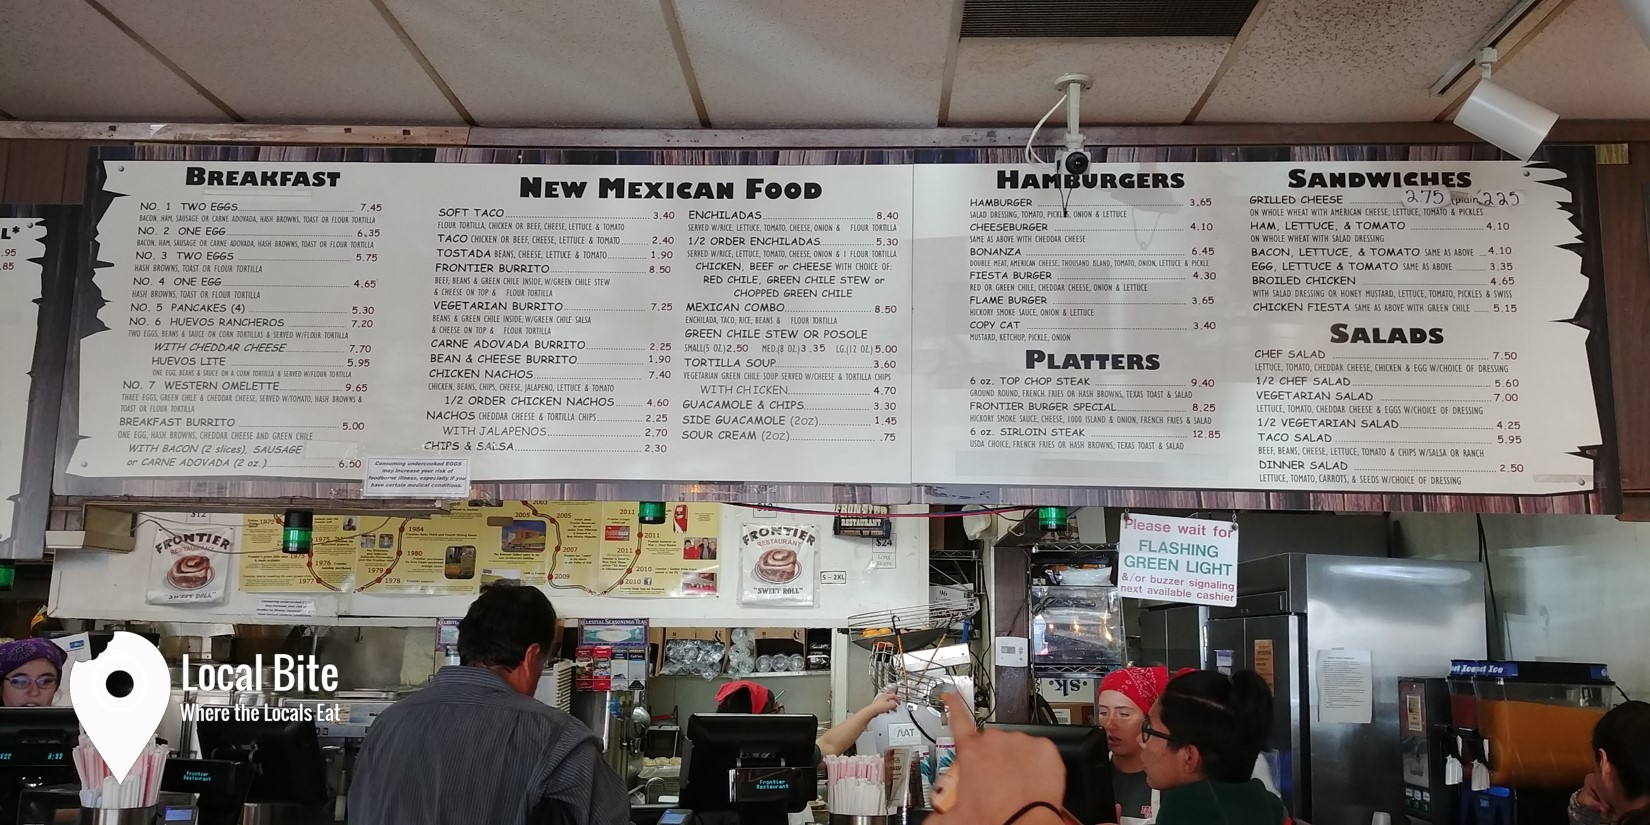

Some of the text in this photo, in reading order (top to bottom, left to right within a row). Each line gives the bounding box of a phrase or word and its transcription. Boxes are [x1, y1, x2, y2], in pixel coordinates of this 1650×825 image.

[186, 167, 340, 187] BREAKFAST
[520, 177, 822, 199] NEW MEXICAN FOOD
[971, 198, 1211, 207] HAMBURGER 3.65
[1250, 195, 1343, 204] GRILLED CHEESE
[211, 203, 239, 211] EGGS
[439, 208, 469, 217] SOFT
[474, 209, 504, 217] TACO
[689, 210, 898, 220] ENCHILADAS 8.40
[970, 223, 1048, 231] CHEESEBURGER
[1251, 222, 1279, 231] HAM,
[1286, 221, 1337, 231] LETTUCE,
[1356, 222, 1405, 230] TOMATO
[1486, 222, 1509, 230] 4.10
[437, 249, 491, 258] TOSTADA
[495, 250, 515, 258] BEANS,
[518, 250, 543, 259] CHEESE,
[575, 251, 579, 259] &
[583, 251, 609, 259] TOMATO
[652, 251, 673, 259] 1.90
[970, 247, 1214, 256] BONANZA 6.45
[153, 264, 179, 272] BROWNS,
[436, 263, 493, 272] FRONTIER
[499, 264, 549, 273] BURRITO
[970, 271, 1216, 280] FIESTA BURGER 4.30
[1253, 276, 1514, 285] BROILED CHICKEN 4.65
[734, 289, 852, 298] CHOPPED GREEN CHILE
[131, 303, 374, 314] NO. 5 PANCAKES (4) 5.30
[686, 302, 897, 313] MEXICAN COMBO 8.50
[685, 329, 867, 339] GREEN CHILE STEW OR POSOLE
[1331, 323, 1443, 344] SALADS
[1026, 350, 1160, 370] PLATTERS
[1255, 350, 1517, 360] CHEF SALAD 7.50
[152, 357, 370, 367] HUEVOS LITE 5.95
[429, 369, 671, 379] CHICKEN NACHOS 7.40
[1000, 377, 1020, 385] TOP
[1025, 377, 1052, 385] CHOP
[1056, 377, 1090, 385] STEAK
[1191, 379, 1214, 387] 9.40
[1256, 391, 1330, 400] VEGETARIAN
[1336, 392, 1373, 401] SALAD
[683, 400, 896, 410] GUACAMOLE & CHIPS 3.30
[120, 417, 364, 430] BREAKFAST BURRITO 5.00
[682, 431, 713, 439] SOUR
[718, 431, 756, 440] CREAM
[1259, 460, 1523, 472] DINNER SALAD 2.50
[1124, 518, 1233, 539] Please wait for
[741, 526, 816, 547] FRONTIER
[155, 532, 231, 554] FRONTIER
[756, 538, 803, 547] RESTAURANT
[1139, 539, 1219, 558] FLASHING
[1124, 555, 1233, 577] GREEN LIGHT
[1121, 572, 1235, 593] &/or buzzer signaling
[1120, 584, 1235, 602] next available cashier
